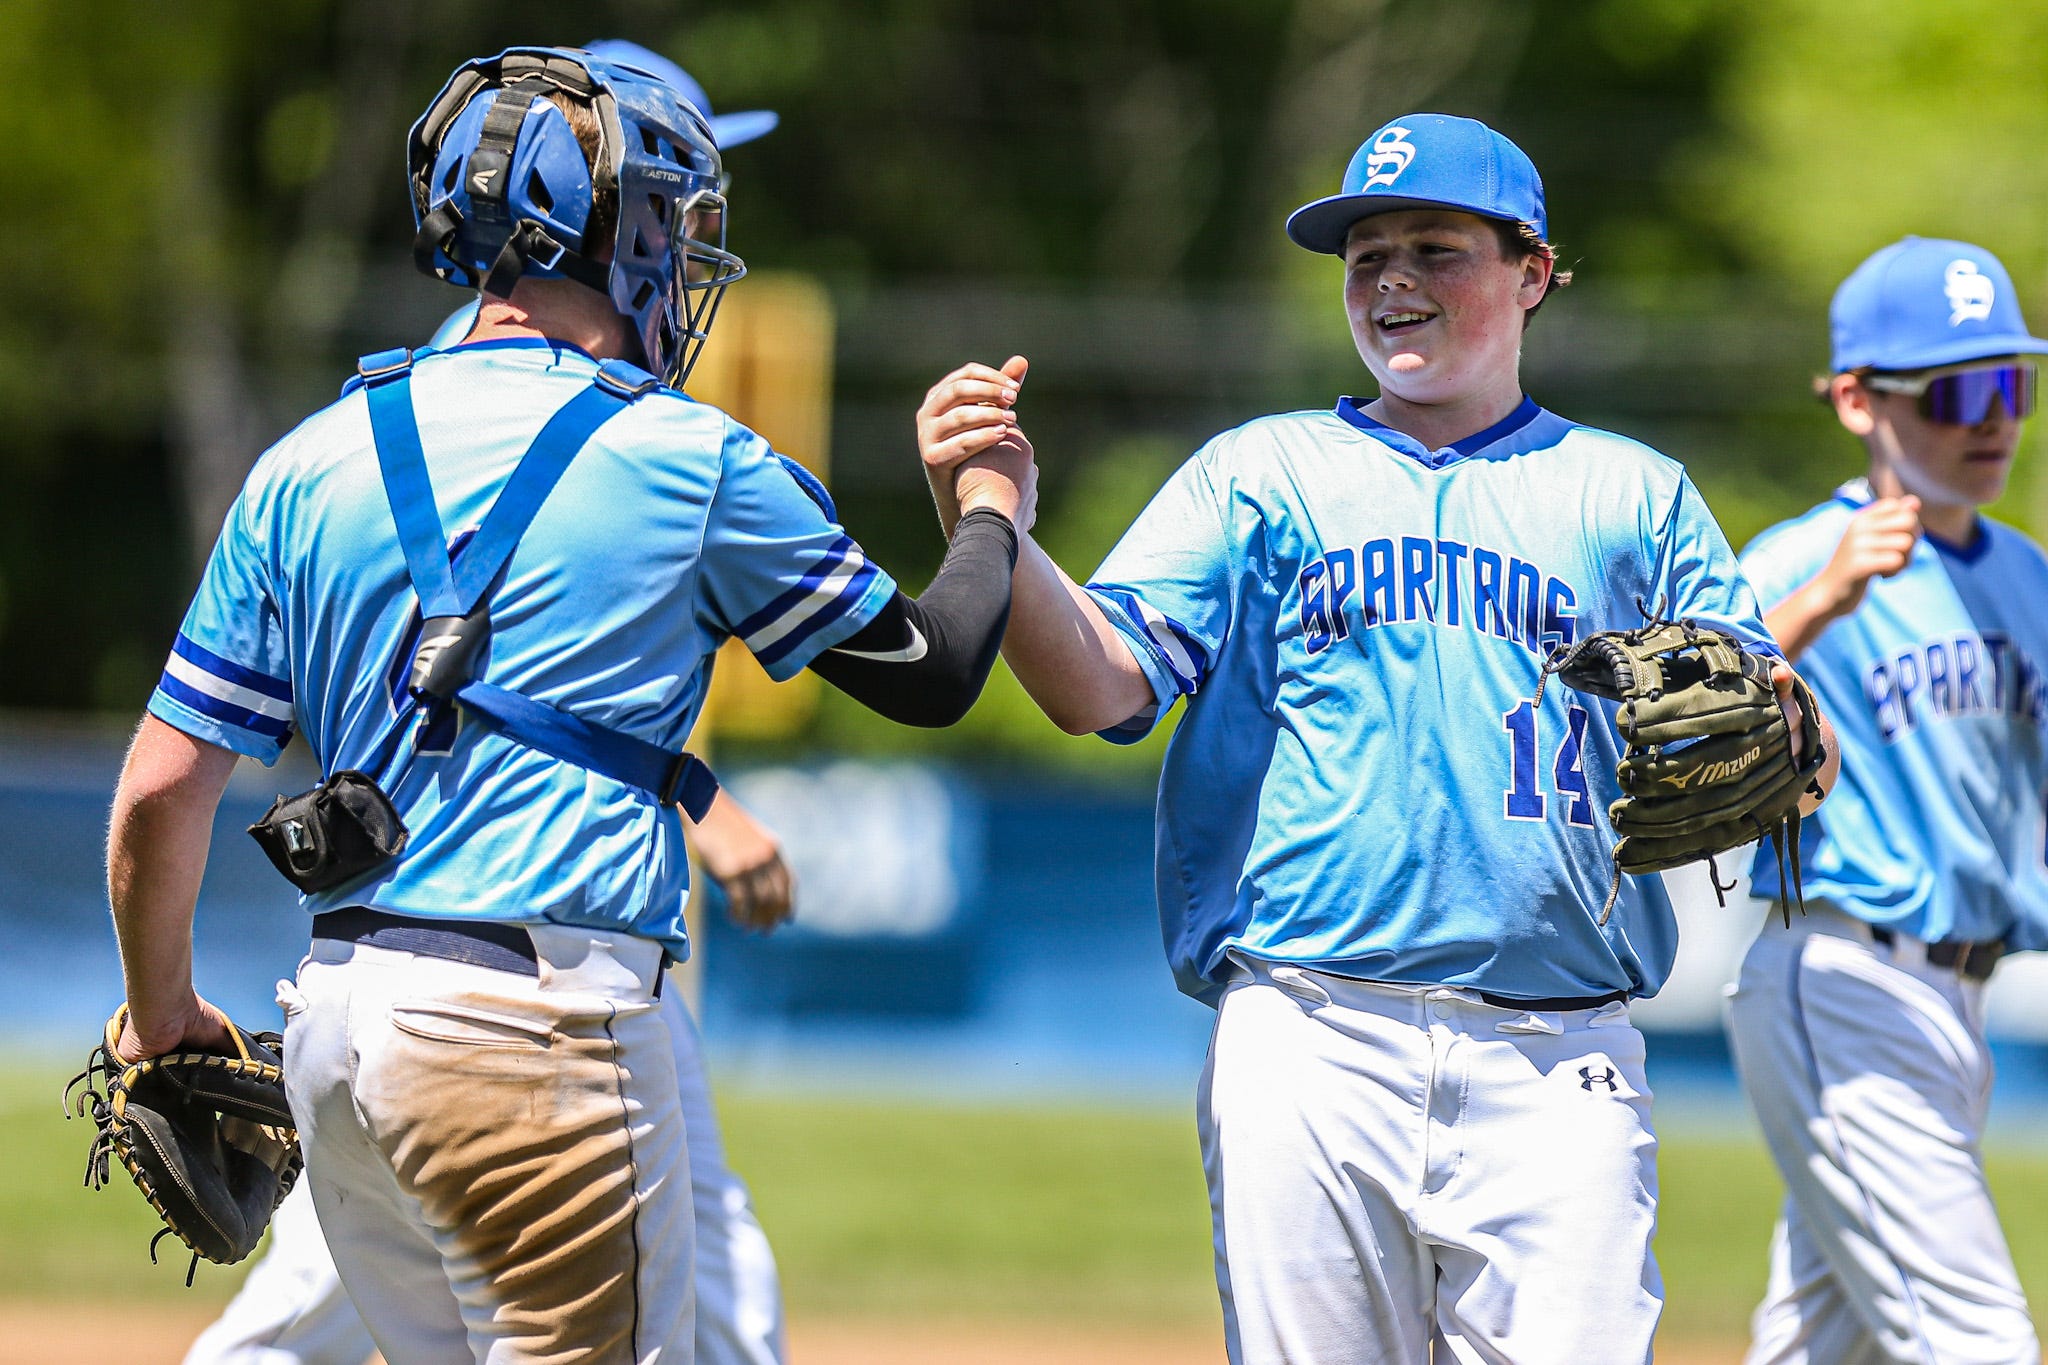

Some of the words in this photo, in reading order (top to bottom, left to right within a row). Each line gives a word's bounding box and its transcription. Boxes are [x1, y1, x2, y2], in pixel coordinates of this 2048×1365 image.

[641, 168, 682, 183] EASTON
[1362, 126, 1417, 193] S
[1299, 536, 1577, 657] SPARTANS
[1503, 699, 1595, 829] 14
